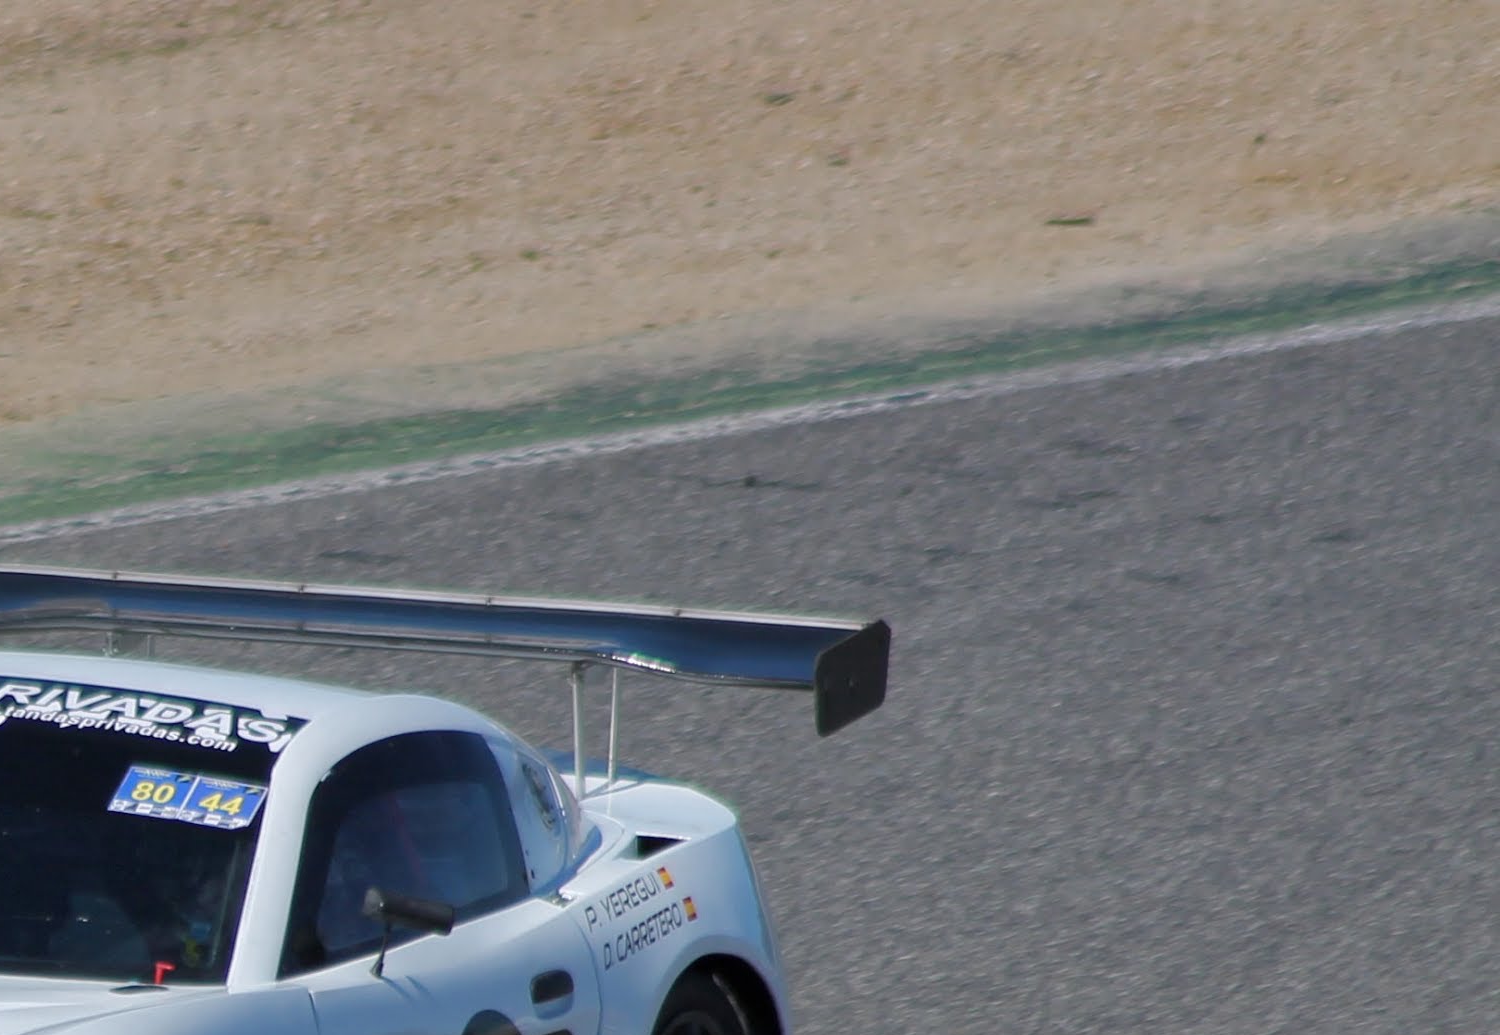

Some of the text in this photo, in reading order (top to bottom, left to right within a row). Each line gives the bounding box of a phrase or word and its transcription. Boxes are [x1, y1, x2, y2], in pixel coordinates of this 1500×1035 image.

[131, 781, 176, 804] 80
[198, 792, 245, 816] 44
[600, 872, 662, 923] YEREGUI
[616, 903, 682, 962] CARRETERO
